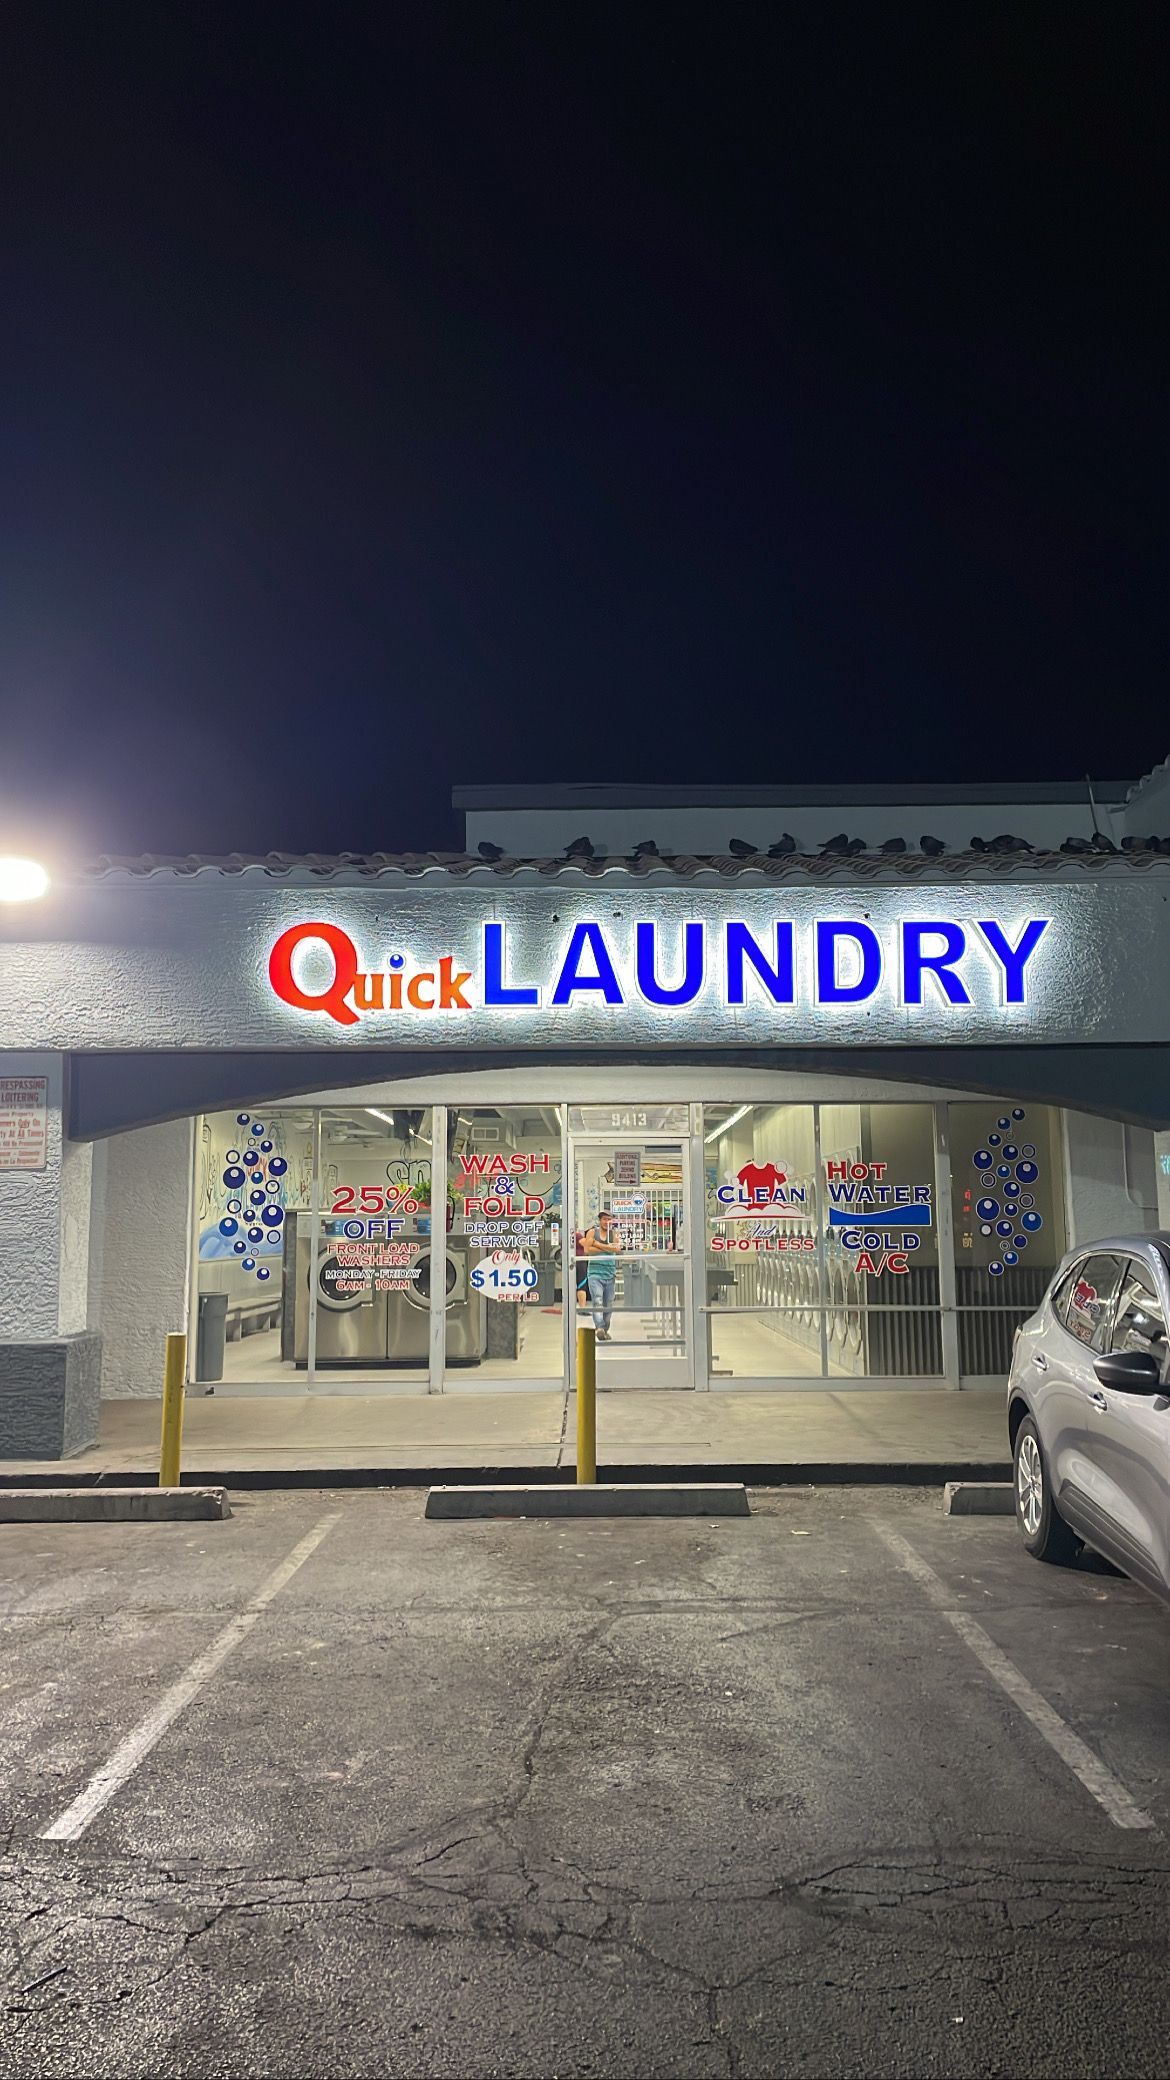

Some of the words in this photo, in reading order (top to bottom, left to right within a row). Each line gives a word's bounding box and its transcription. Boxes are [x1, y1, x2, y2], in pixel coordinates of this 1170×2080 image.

[269, 921, 472, 1025] Quick
[482, 917, 1053, 1009] LAUNDRY
[2, 1092, 39, 1102] LOITERING
[458, 1153, 550, 1174] WASH
[494, 1176, 514, 1195] &
[716, 1185, 806, 1204] CLEAN
[827, 1183, 932, 1204] WATER
[331, 1185, 418, 1215] 25%
[463, 1196, 545, 1217] FOLD
[343, 1218, 405, 1239] OFF
[464, 1221, 509, 1234] DROP
[512, 1221, 544, 1234] OFF
[327, 1243, 378, 1254] FRONT
[380, 1243, 420, 1254] LOAD
[470, 1235, 539, 1247] SERVICE
[710, 1237, 816, 1251] SPOTLESS
[841, 1230, 921, 1250] COLD
[336, 1254, 411, 1266] WASHERS
[491, 1250, 521, 1265] Only
[854, 1252, 910, 1277] A/C
[375, 1280, 410, 1291] 10AM
[470, 1269, 538, 1288] $1.50
[497, 1293, 521, 1303] PER
